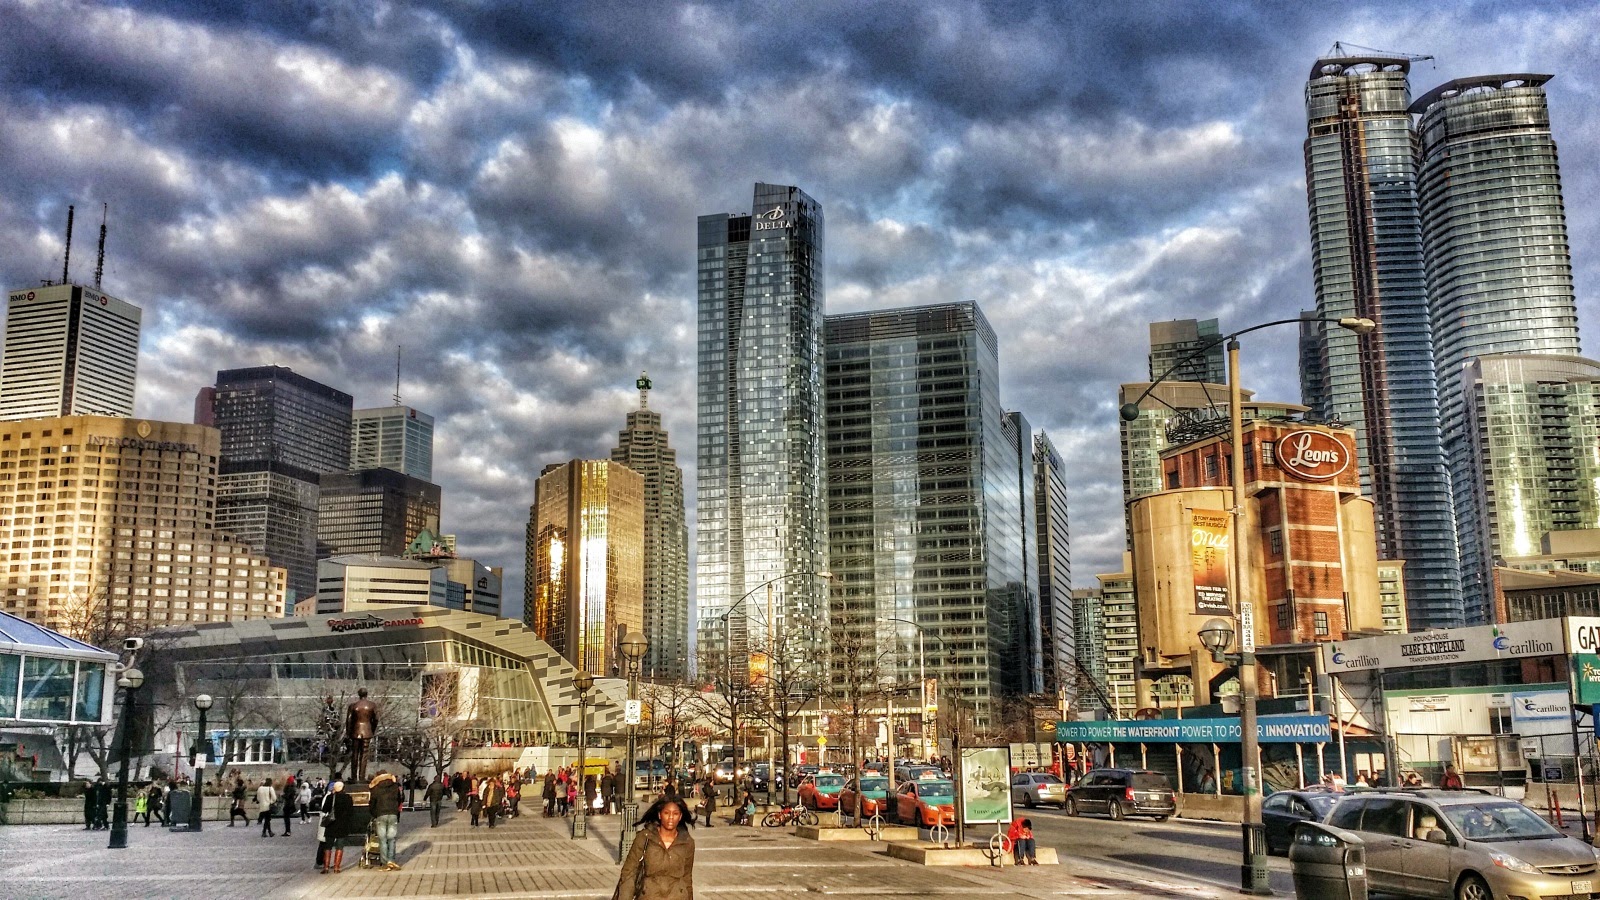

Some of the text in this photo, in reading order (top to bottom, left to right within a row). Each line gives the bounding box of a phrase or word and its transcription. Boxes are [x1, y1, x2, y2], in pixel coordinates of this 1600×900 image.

[755, 221, 793, 231] DELTA
[10, 294, 26, 302] BMO
[84, 290, 100, 302] BMO
[1289, 433, 1339, 468] Leon's
[331, 619, 380, 632] AQUARIUM
[383, 617, 425, 628] CANADA
[1413, 632, 1449, 643] ROUNDHOUSE
[1509, 639, 1554, 655] carillion
[1345, 654, 1380, 669] carillion
[1440, 654, 1459, 662] STATION
[1536, 703, 1567, 713] carillion
[1057, 723, 1330, 737] POWER TO POWER THE WATERFRONT POWER TO POR INNOVATION
